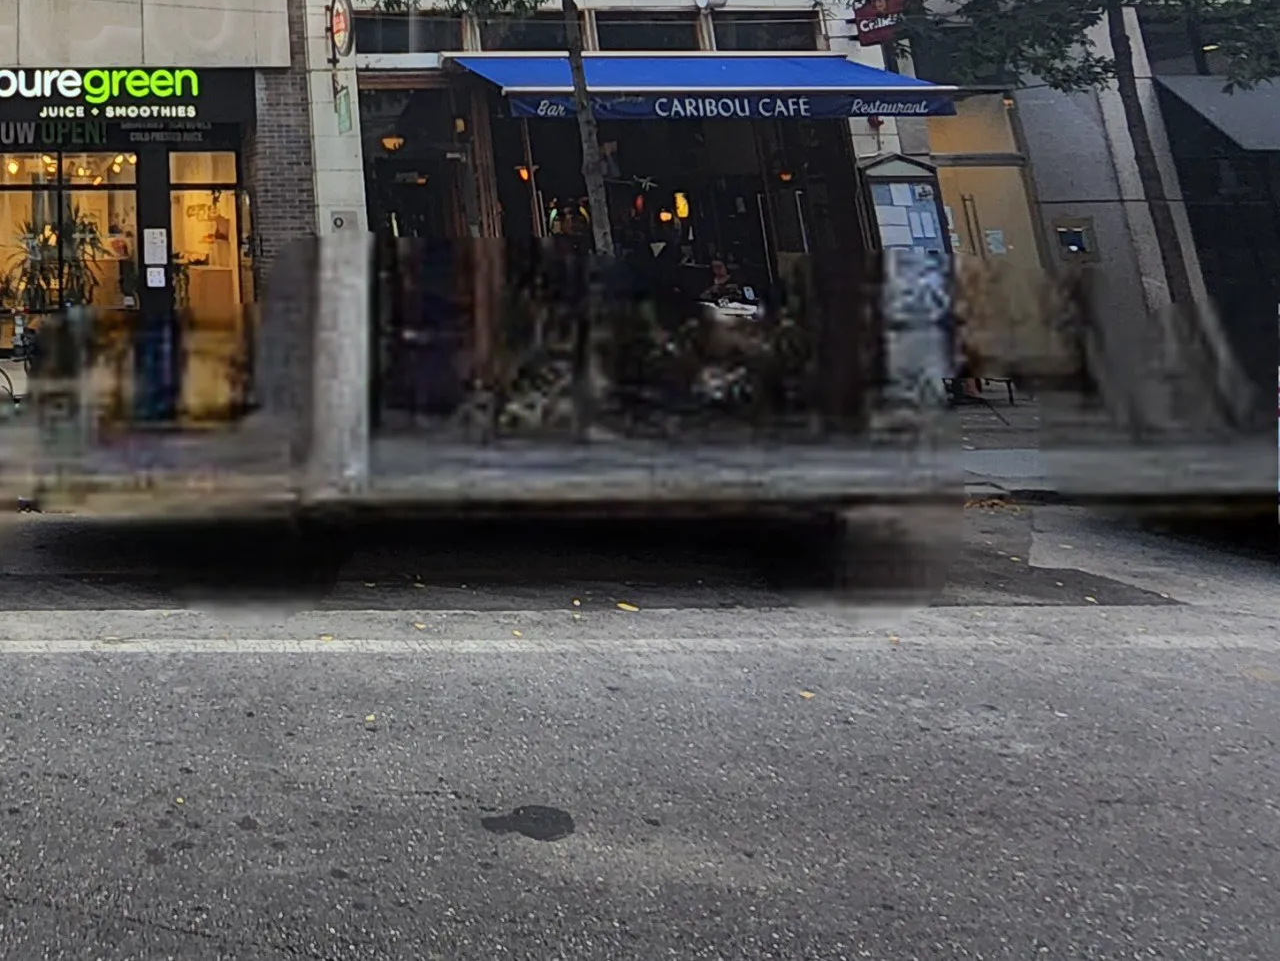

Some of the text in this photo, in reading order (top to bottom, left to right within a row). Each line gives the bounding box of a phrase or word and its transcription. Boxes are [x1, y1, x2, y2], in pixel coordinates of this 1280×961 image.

[39, 106, 85, 118] JUICE
[105, 106, 196, 118] SMOOTHIES
[537, 99, 566, 117] Bar
[654, 98, 750, 117] CARIBOU
[850, 99, 929, 114] Restaurant
